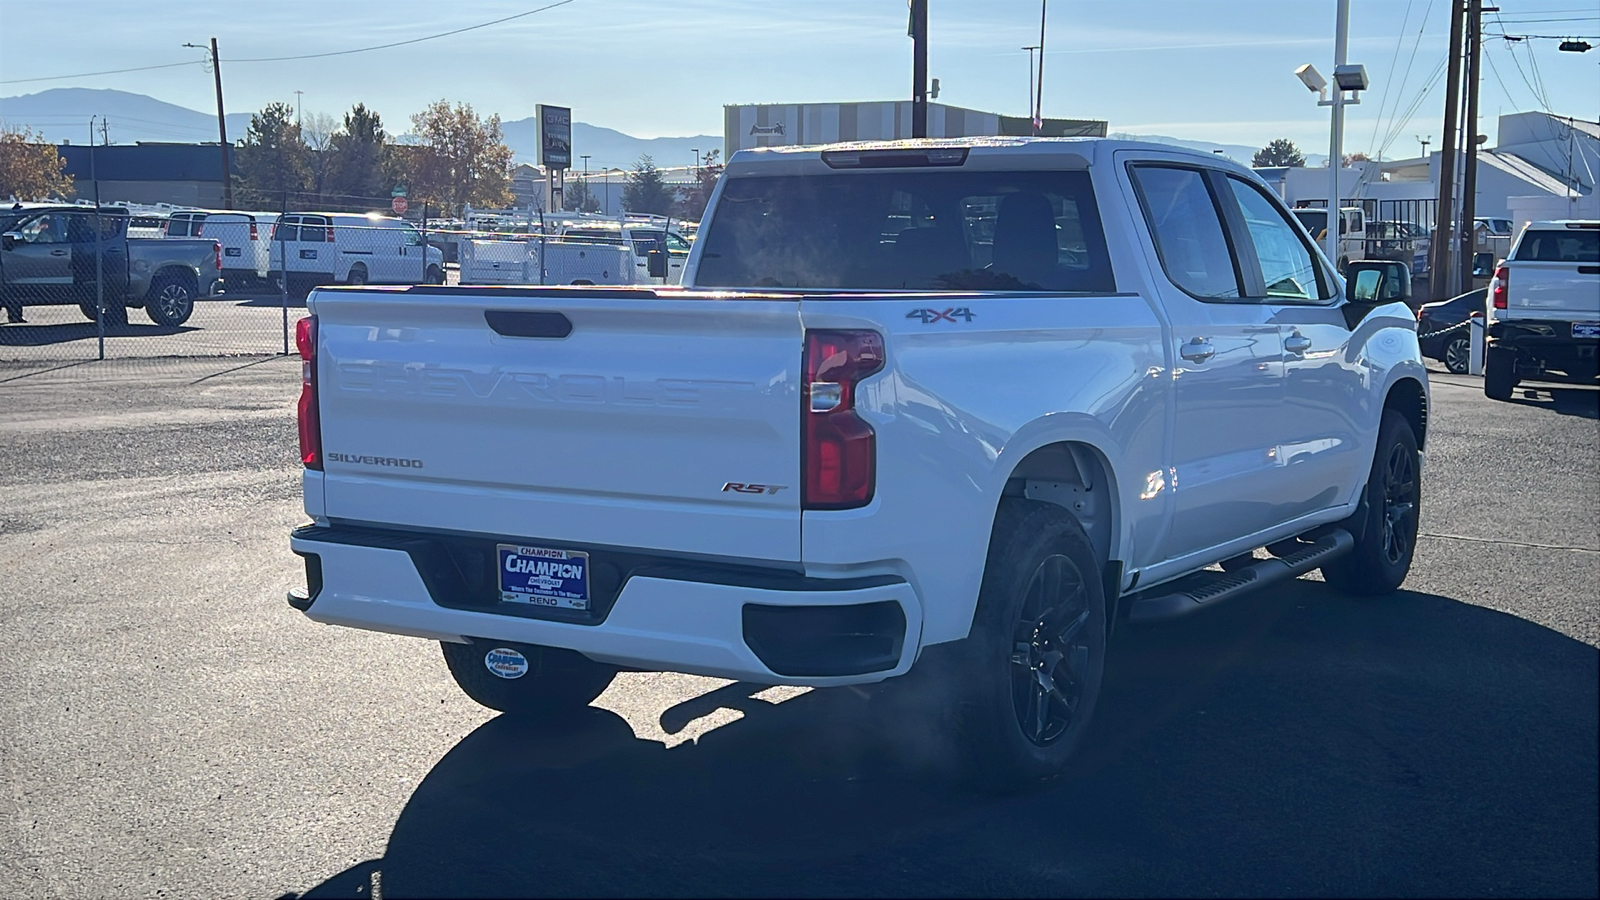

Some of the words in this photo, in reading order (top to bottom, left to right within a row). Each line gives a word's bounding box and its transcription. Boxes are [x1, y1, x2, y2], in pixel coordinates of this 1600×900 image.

[546, 114, 569, 126] GMC
[392, 201, 407, 209] STOP
[328, 452, 424, 469] SILVERADO
[721, 482, 789, 495] RST
[520, 547, 563, 558] CHAMPION
[505, 554, 583, 579] CHAMPION
[530, 577, 561, 586] CHEVROLET
[529, 596, 558, 606] RENO
